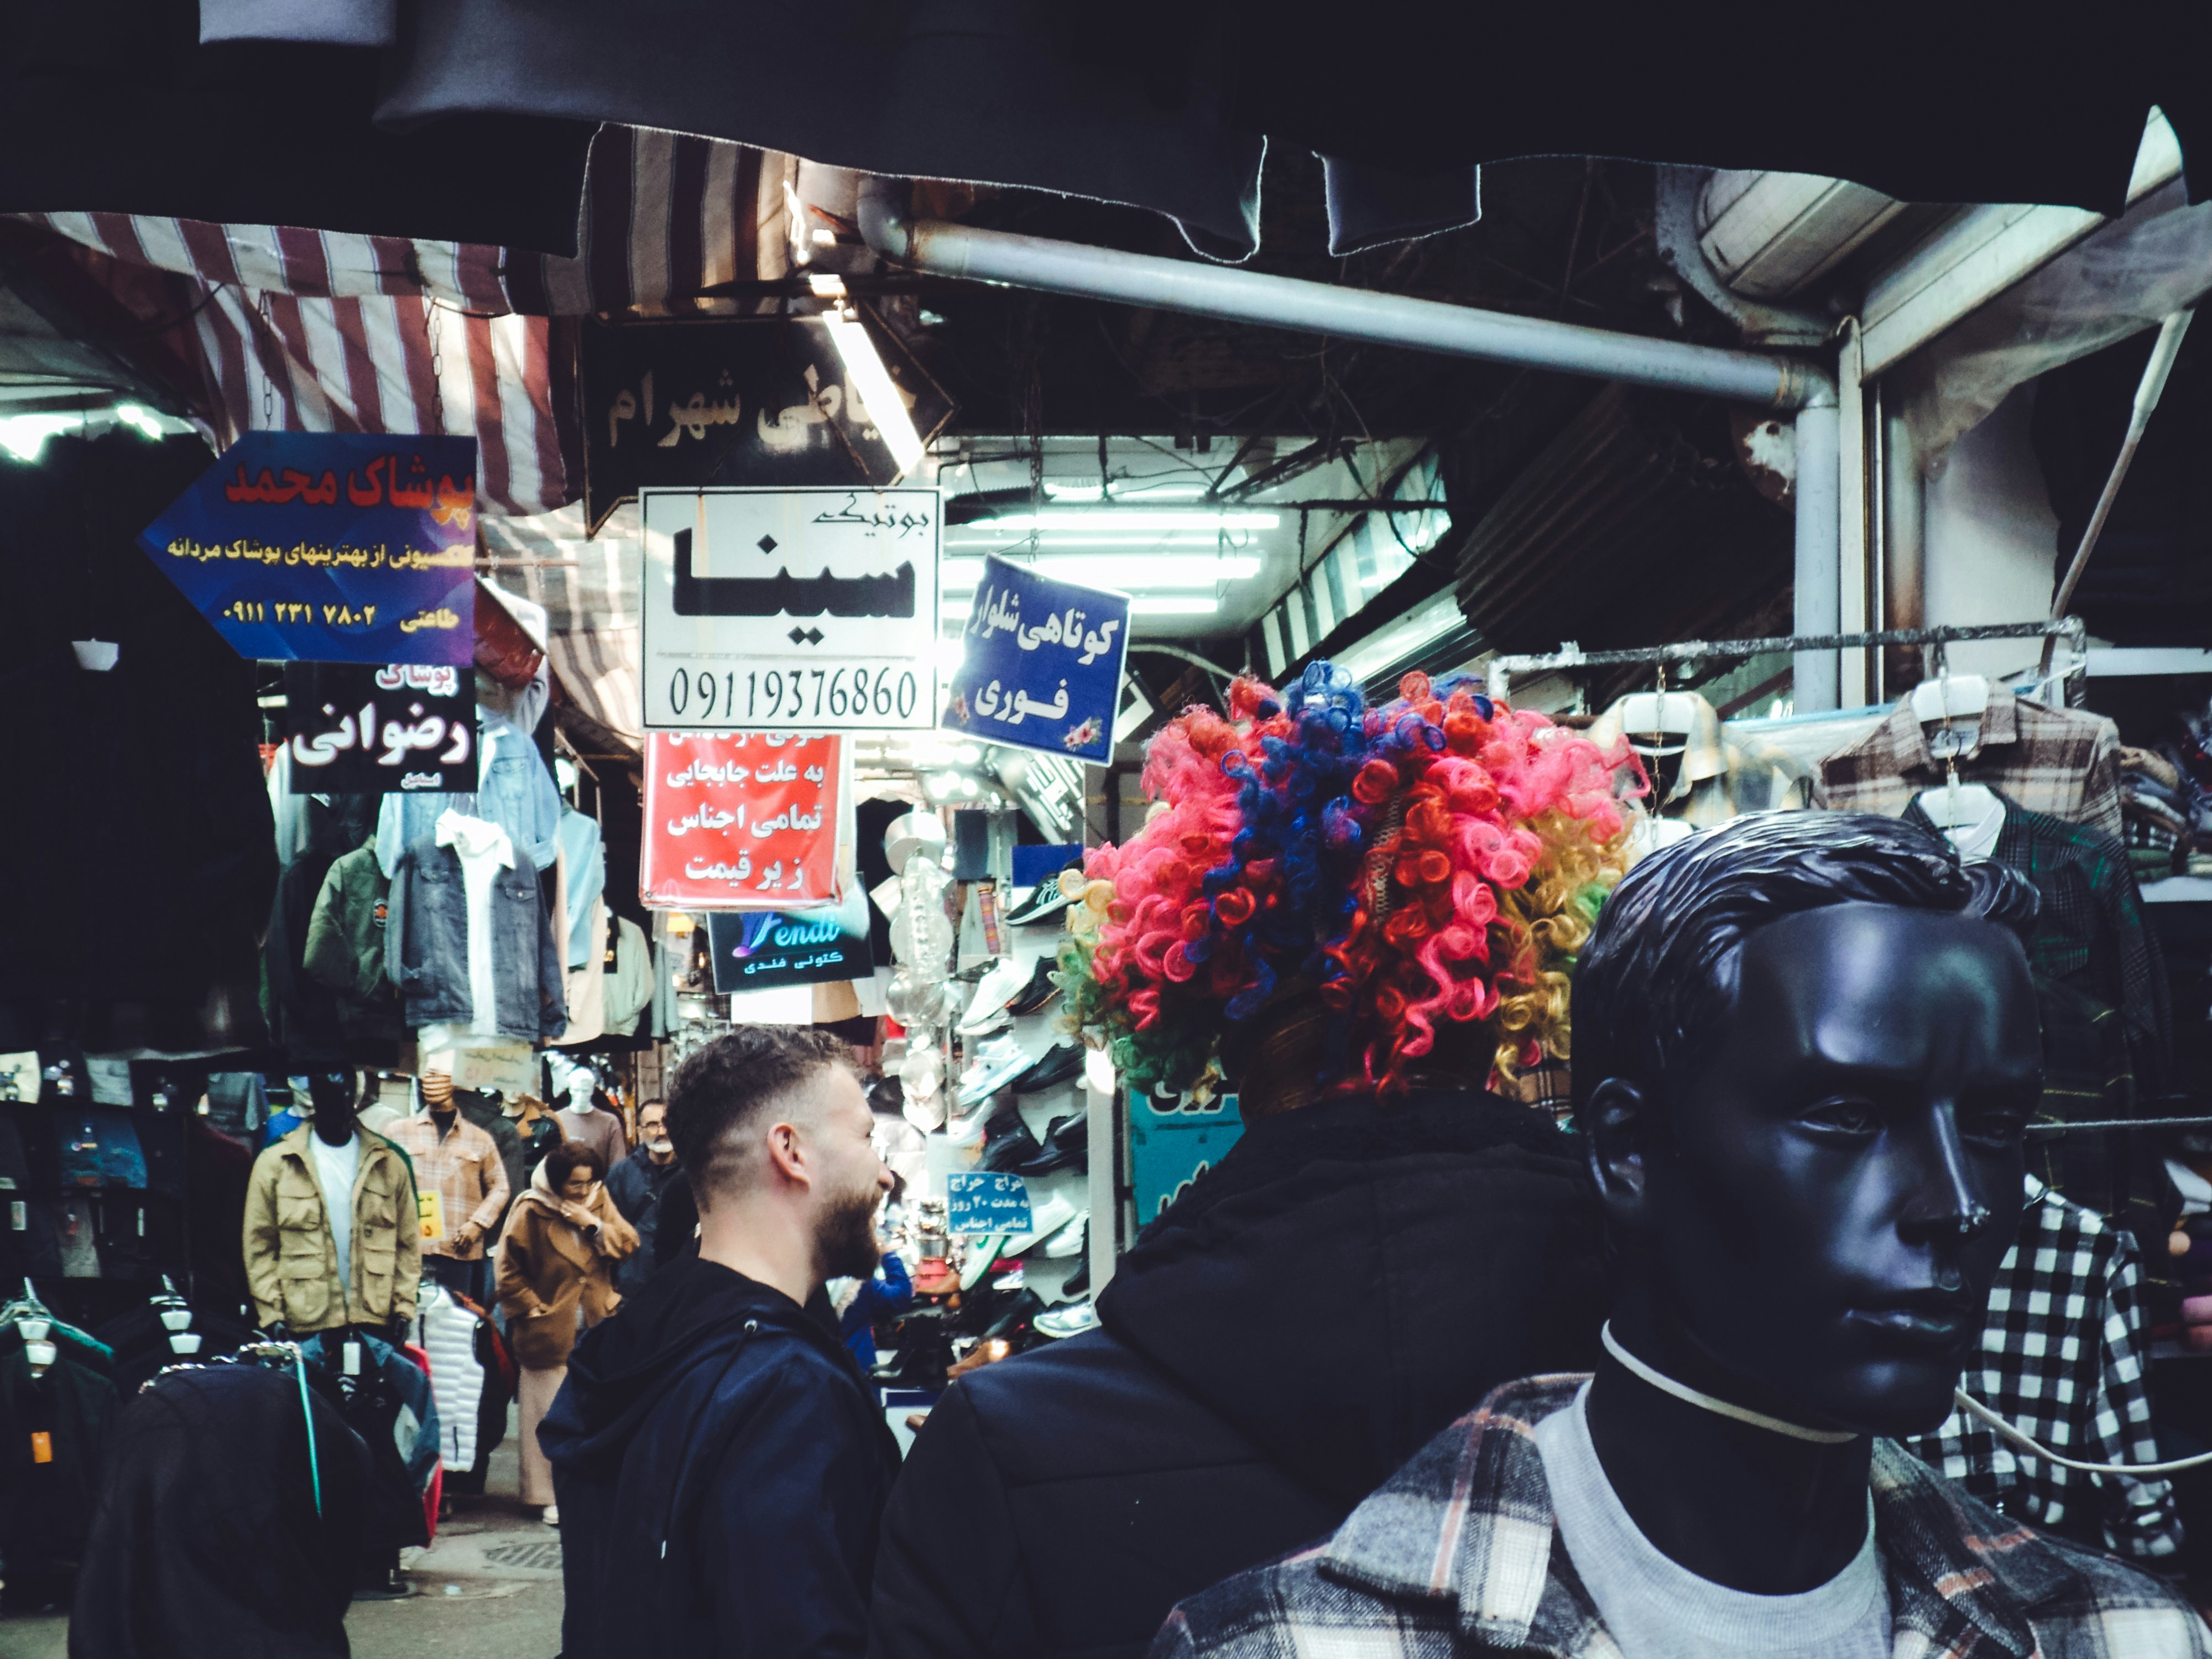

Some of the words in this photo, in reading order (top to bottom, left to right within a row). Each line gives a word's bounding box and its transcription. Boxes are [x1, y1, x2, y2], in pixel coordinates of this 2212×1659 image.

[608, 368, 742, 448] شهرام
[225, 461, 338, 505] محمد
[347, 455, 474, 530] پوشاک
[811, 492, 929, 539] بوتیک
[168, 537, 221, 562] مردانه
[225, 540, 281, 564] پوشاک
[285, 541, 368, 568] بهترینهای
[370, 544, 384, 568] از
[673, 527, 915, 646] سینا
[969, 584, 1020, 638] شلوار
[1018, 608, 1119, 666] کوتاهی
[375, 664, 458, 696] پوشاک
[670, 667, 916, 719] 09119376860
[974, 678, 1070, 724] فوری
[293, 701, 469, 766] رضوانی
[666, 759, 749, 788] جابجایی
[755, 759, 798, 783] علت
[804, 764, 825, 789] به
[667, 802, 746, 837] اجناس
[750, 803, 823, 838] تمامی
[685, 849, 752, 888] قیمت
[756, 857, 804, 890] زیر
[744, 958, 787, 974] فندی
[794, 951, 844, 969] کتونی
